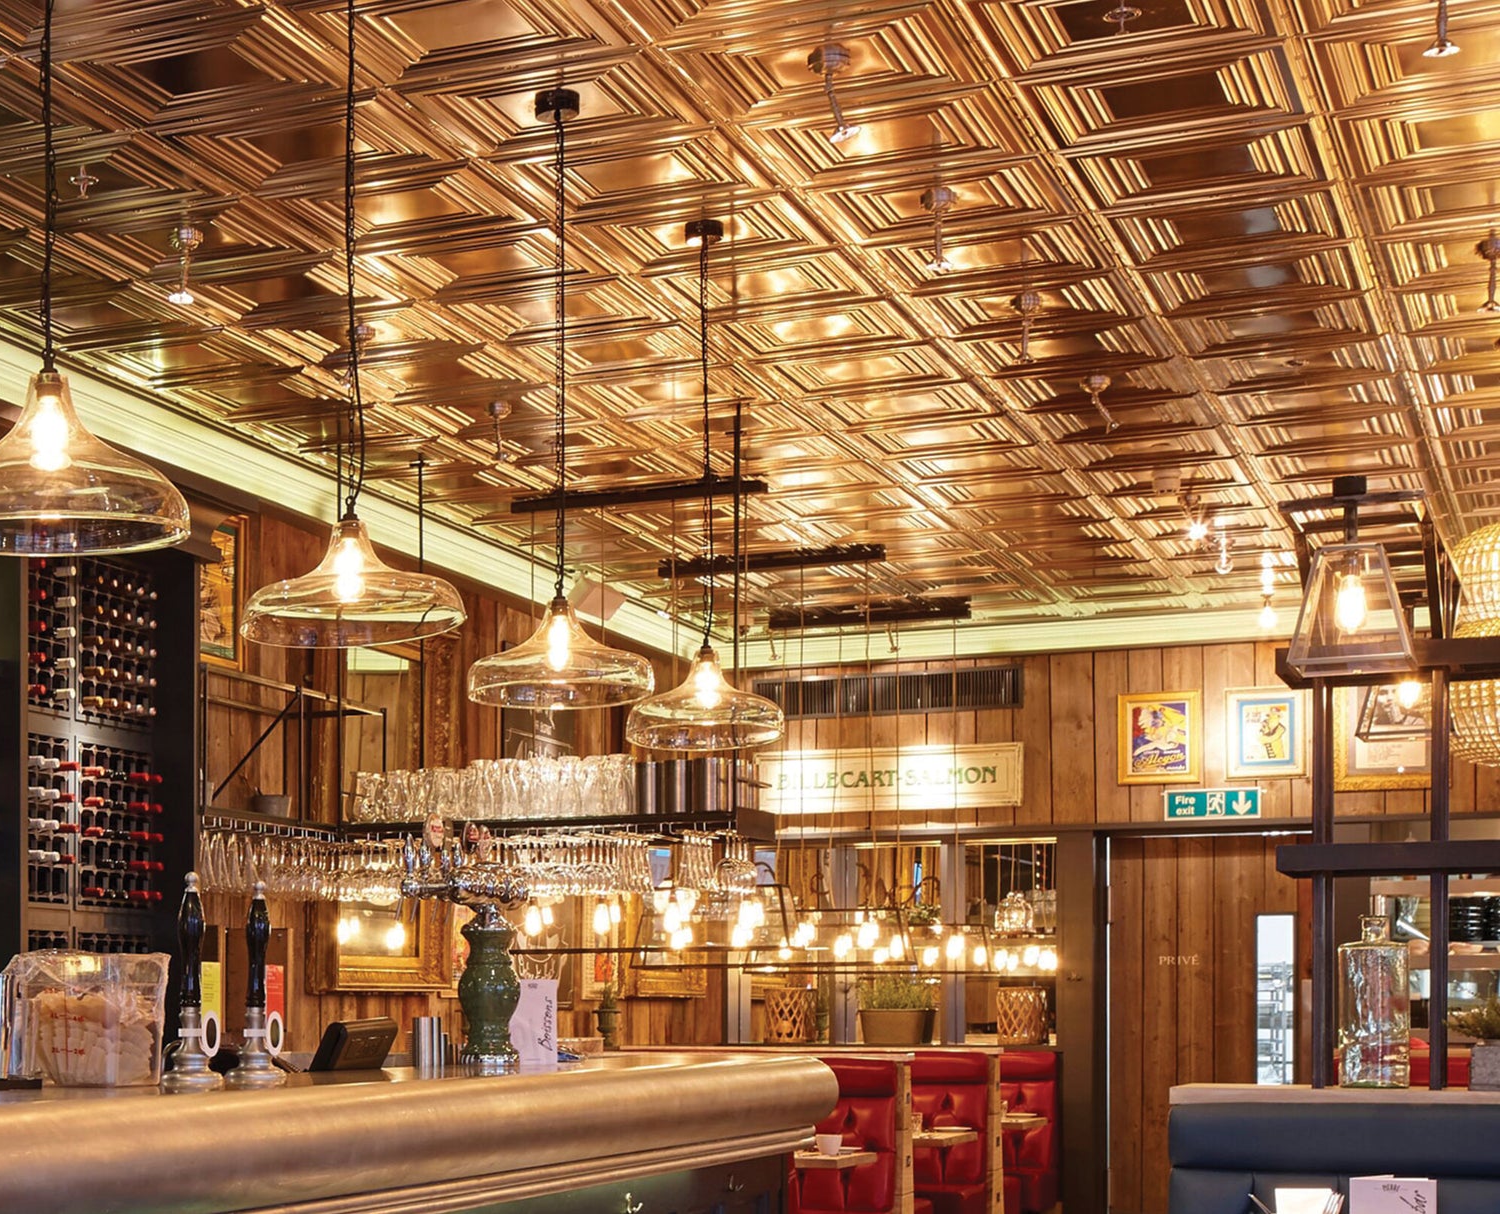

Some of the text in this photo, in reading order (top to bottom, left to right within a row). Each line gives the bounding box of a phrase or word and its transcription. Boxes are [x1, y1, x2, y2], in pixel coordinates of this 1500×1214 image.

[777, 765, 998, 791] BILLECART-SALMON
[1175, 796, 1196, 805] Fire
[1176, 806, 1195, 816] exit
[1158, 953, 1200, 966] PRIVÉ
[537, 996, 553, 1052] Boissons
